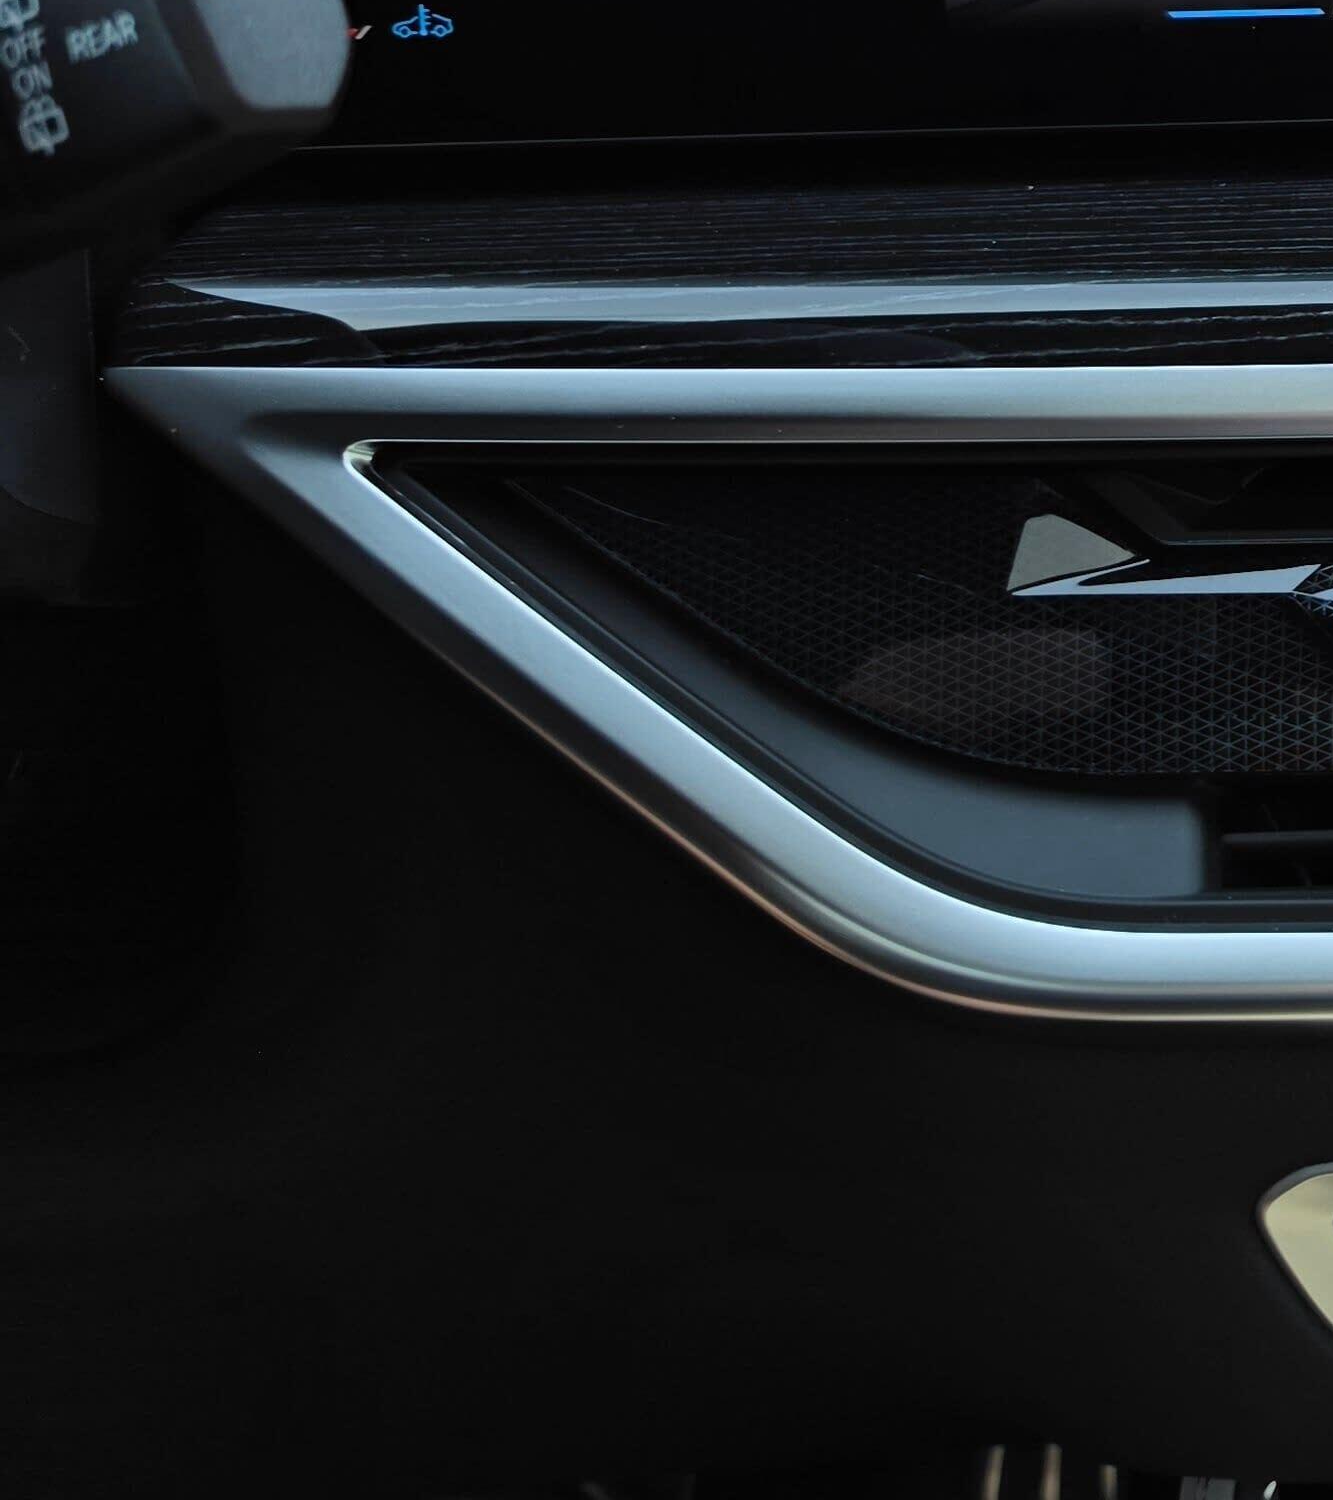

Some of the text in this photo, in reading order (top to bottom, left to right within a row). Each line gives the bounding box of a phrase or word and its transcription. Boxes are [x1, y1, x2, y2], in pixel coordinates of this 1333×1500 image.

[1, 25, 46, 69] OFF
[65, 9, 139, 64] REAR
[12, 62, 53, 100] ON
